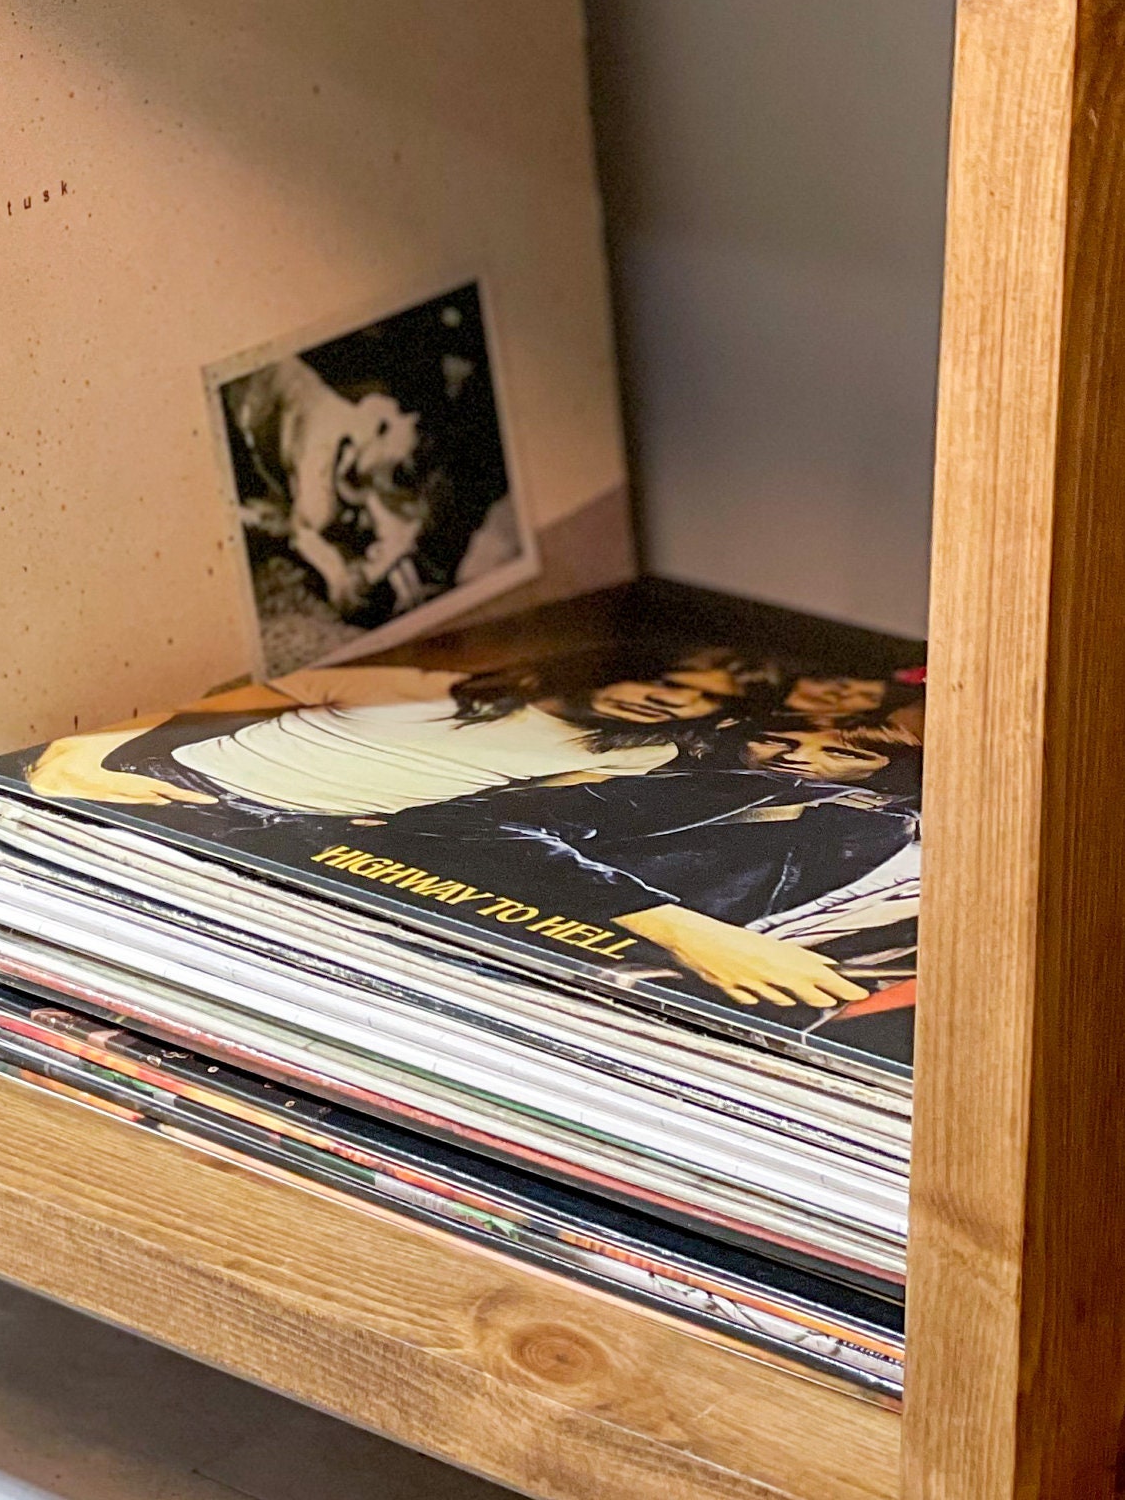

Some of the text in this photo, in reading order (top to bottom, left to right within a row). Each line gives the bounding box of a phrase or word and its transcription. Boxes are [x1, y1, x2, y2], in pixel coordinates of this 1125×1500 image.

[311, 845, 639, 960] HIGHWAY TO HELL
